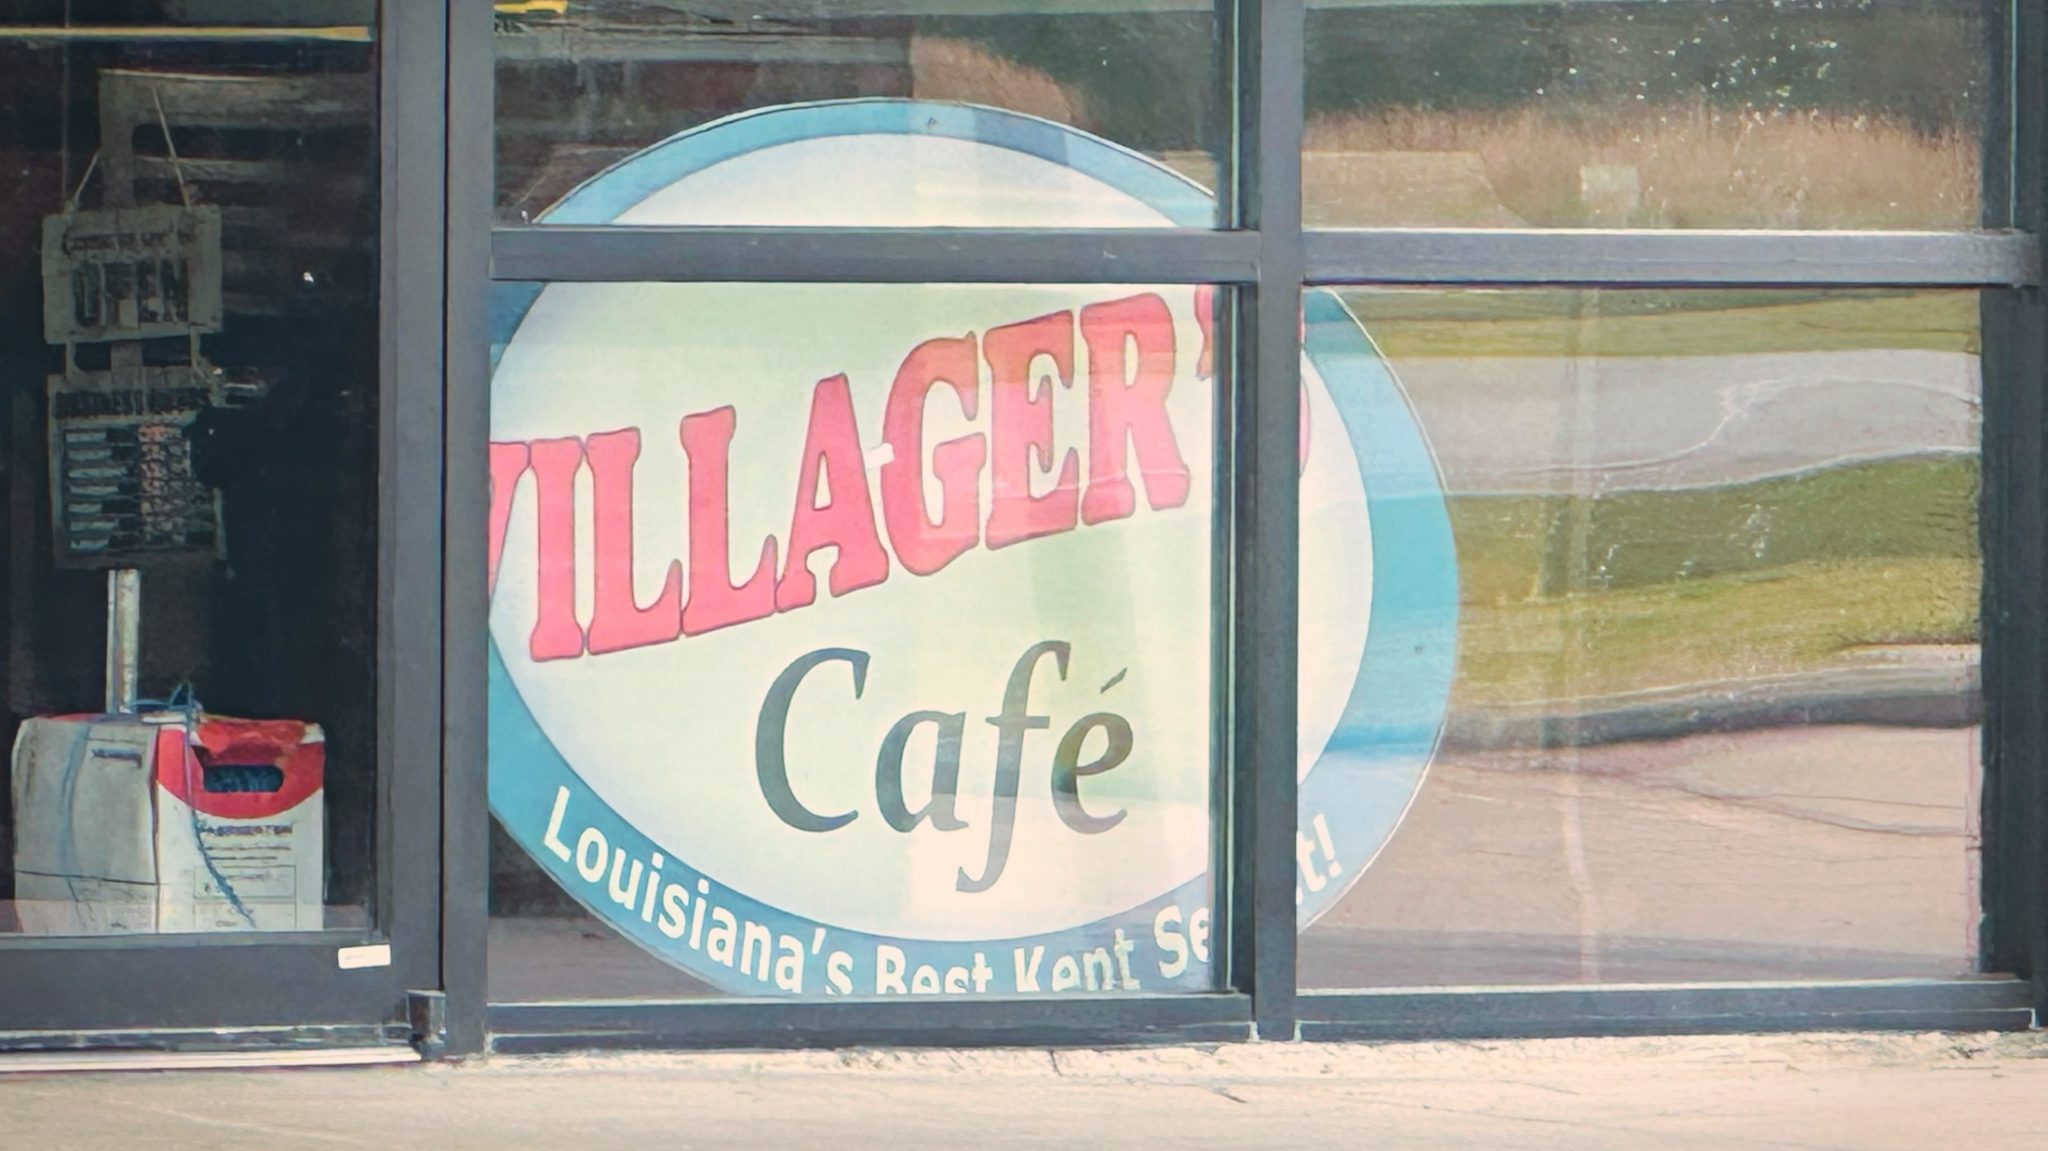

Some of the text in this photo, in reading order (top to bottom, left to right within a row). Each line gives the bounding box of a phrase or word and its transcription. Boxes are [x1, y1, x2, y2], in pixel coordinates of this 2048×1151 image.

[487, 284, 1310, 662] ILLAGER
[544, 785, 853, 996] Louisiana's
[755, 640, 1134, 893] Café
